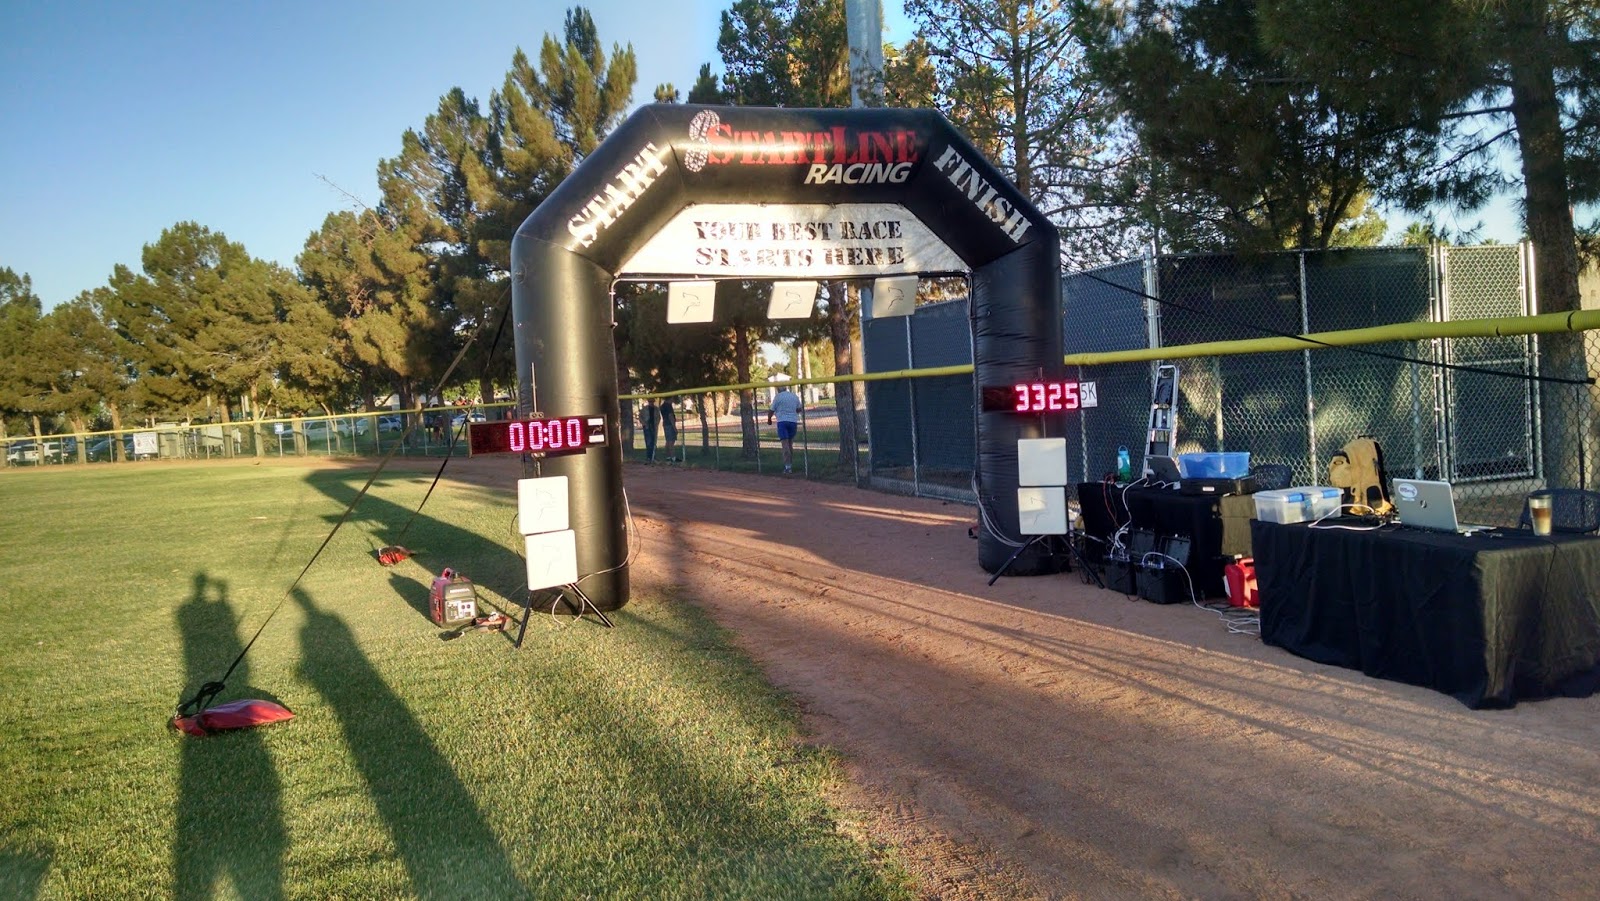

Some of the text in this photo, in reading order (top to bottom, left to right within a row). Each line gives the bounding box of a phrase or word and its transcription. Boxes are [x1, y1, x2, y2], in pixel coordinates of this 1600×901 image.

[804, 162, 914, 185] RACING
[567, 142, 668, 248] START
[933, 144, 1033, 244] FINISH
[693, 220, 903, 241] YOUR BEST RACE
[825, 246, 905, 266] HERE
[1015, 383, 1079, 411] 3325
[1080, 382, 1097, 401] 5K
[509, 419, 581, 452] 00:00
